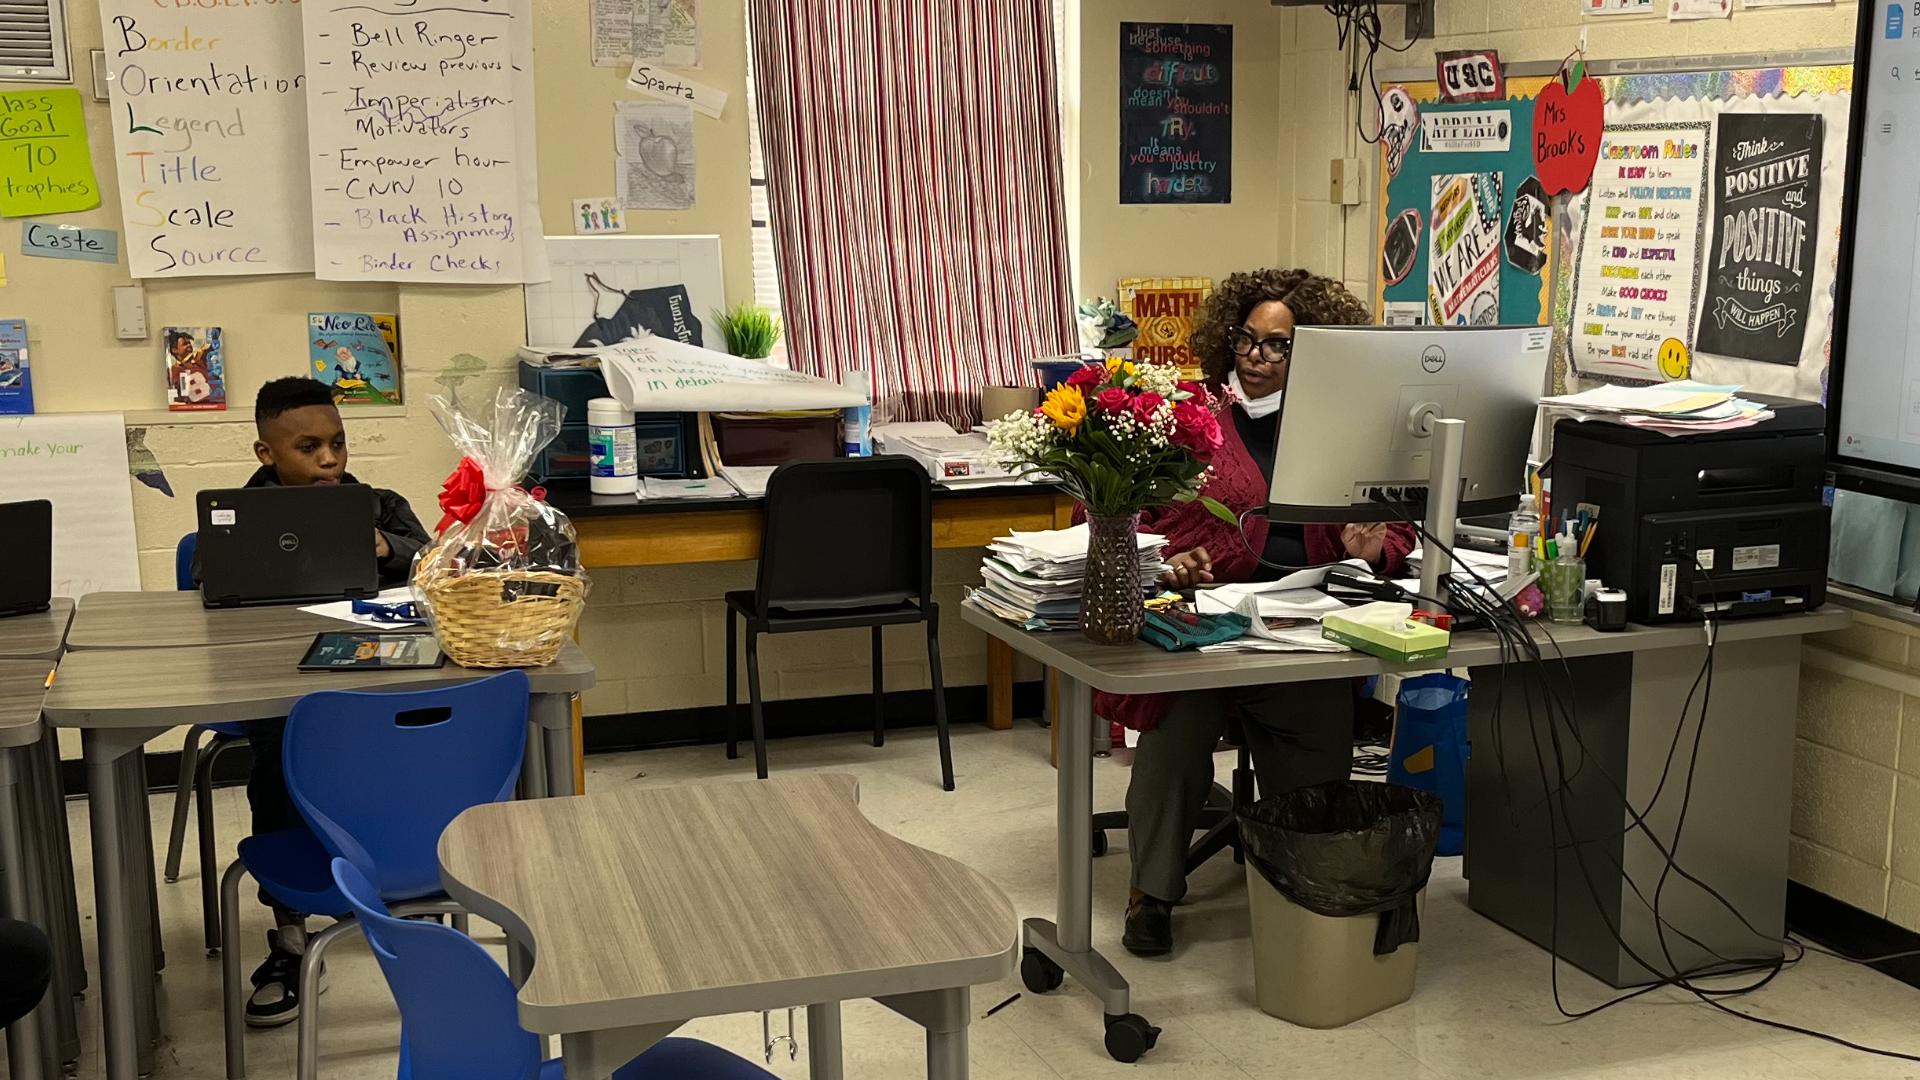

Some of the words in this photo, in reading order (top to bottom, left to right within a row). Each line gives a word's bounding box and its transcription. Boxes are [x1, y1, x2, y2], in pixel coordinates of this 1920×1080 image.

[113, 15, 223, 57] Border
[351, 22, 404, 47] Bell
[414, 20, 498, 60] Ringer
[1129, 32, 1182, 46] because
[1144, 42, 1212, 57] something
[351, 50, 427, 78] Review
[439, 59, 502, 77] previous
[120, 62, 305, 97] Orientation
[630, 66, 696, 101] Sparta
[0, 95, 54, 117] lass
[1128, 96, 1163, 107] mean
[1173, 102, 1230, 115] shouldn't
[1543, 101, 1567, 126] Mrs
[0, 113, 56, 138] Goal
[127, 101, 246, 153] Legend
[355, 114, 470, 140] Motivators
[14, 143, 57, 173] 70
[339, 147, 441, 175] Empower
[454, 146, 511, 169] hour
[1130, 153, 1154, 166] you
[1158, 150, 1201, 163] should
[1139, 145, 1183, 156] means
[1601, 140, 1660, 161] Classroom
[1663, 139, 1698, 160] Rules
[1735, 136, 1771, 162] Think
[126, 151, 222, 184] Title
[1170, 160, 1195, 173] just
[1199, 160, 1217, 173] try
[1656, 166, 1673, 179] learn
[1724, 153, 1811, 199] POSITIVE
[4, 176, 90, 201] trophies
[345, 175, 415, 200] CNN
[439, 177, 463, 199] 10
[1617, 187, 1629, 199] and
[1784, 186, 1804, 203] and
[129, 190, 235, 228] Scale
[354, 203, 428, 229] Black
[443, 202, 513, 233] History
[1653, 208, 1665, 220] and
[28, 224, 105, 252] Caste
[1718, 206, 1806, 278] POSITIVE
[150, 234, 267, 272] Source
[361, 252, 415, 273] Binder
[1628, 247, 1640, 259] and
[1433, 254, 1458, 299] WE
[1735, 266, 1782, 304] things
[1135, 292, 1202, 318] MATH
[1617, 306, 1629, 319] and
[1729, 303, 1748, 325] WILL
[1748, 306, 1781, 328] HAPPEN
[318, 314, 352, 332] Neo
[1424, 355, 1443, 363] DELL
